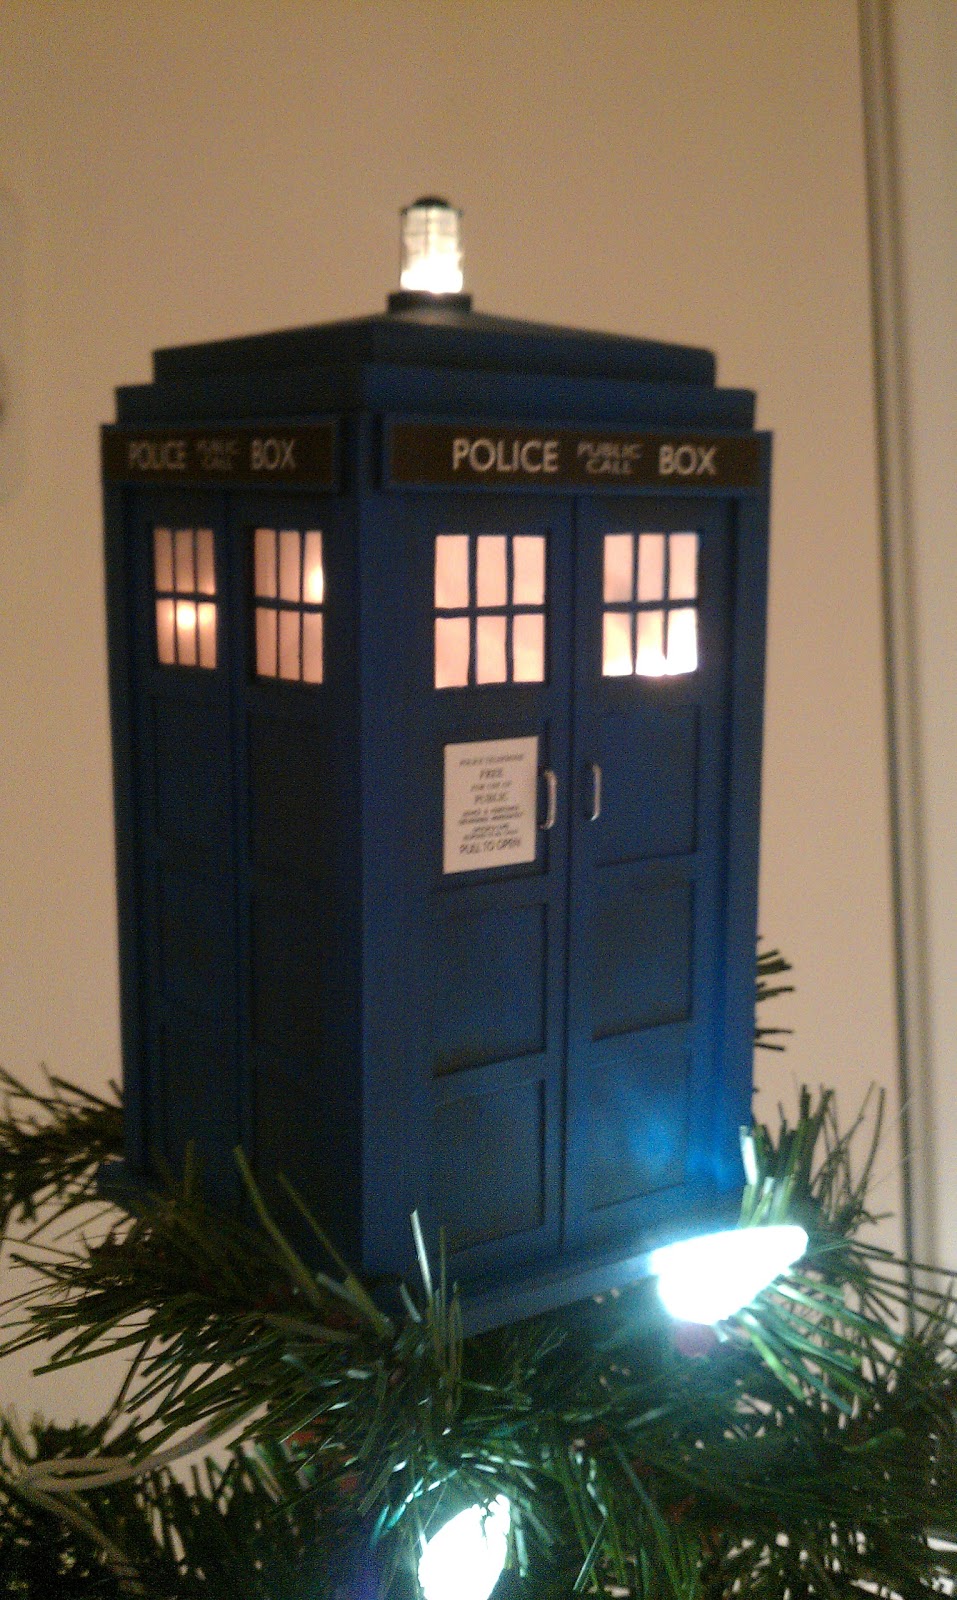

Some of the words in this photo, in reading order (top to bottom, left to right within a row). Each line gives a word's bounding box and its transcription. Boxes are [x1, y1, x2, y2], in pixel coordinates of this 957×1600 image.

[128, 440, 187, 471] POLICE
[251, 438, 297, 471] BOX
[452, 437, 559, 473] POLICE
[659, 443, 719, 476] BOX
[585, 458, 633, 475] CALL
[483, 840, 495, 852] TO
